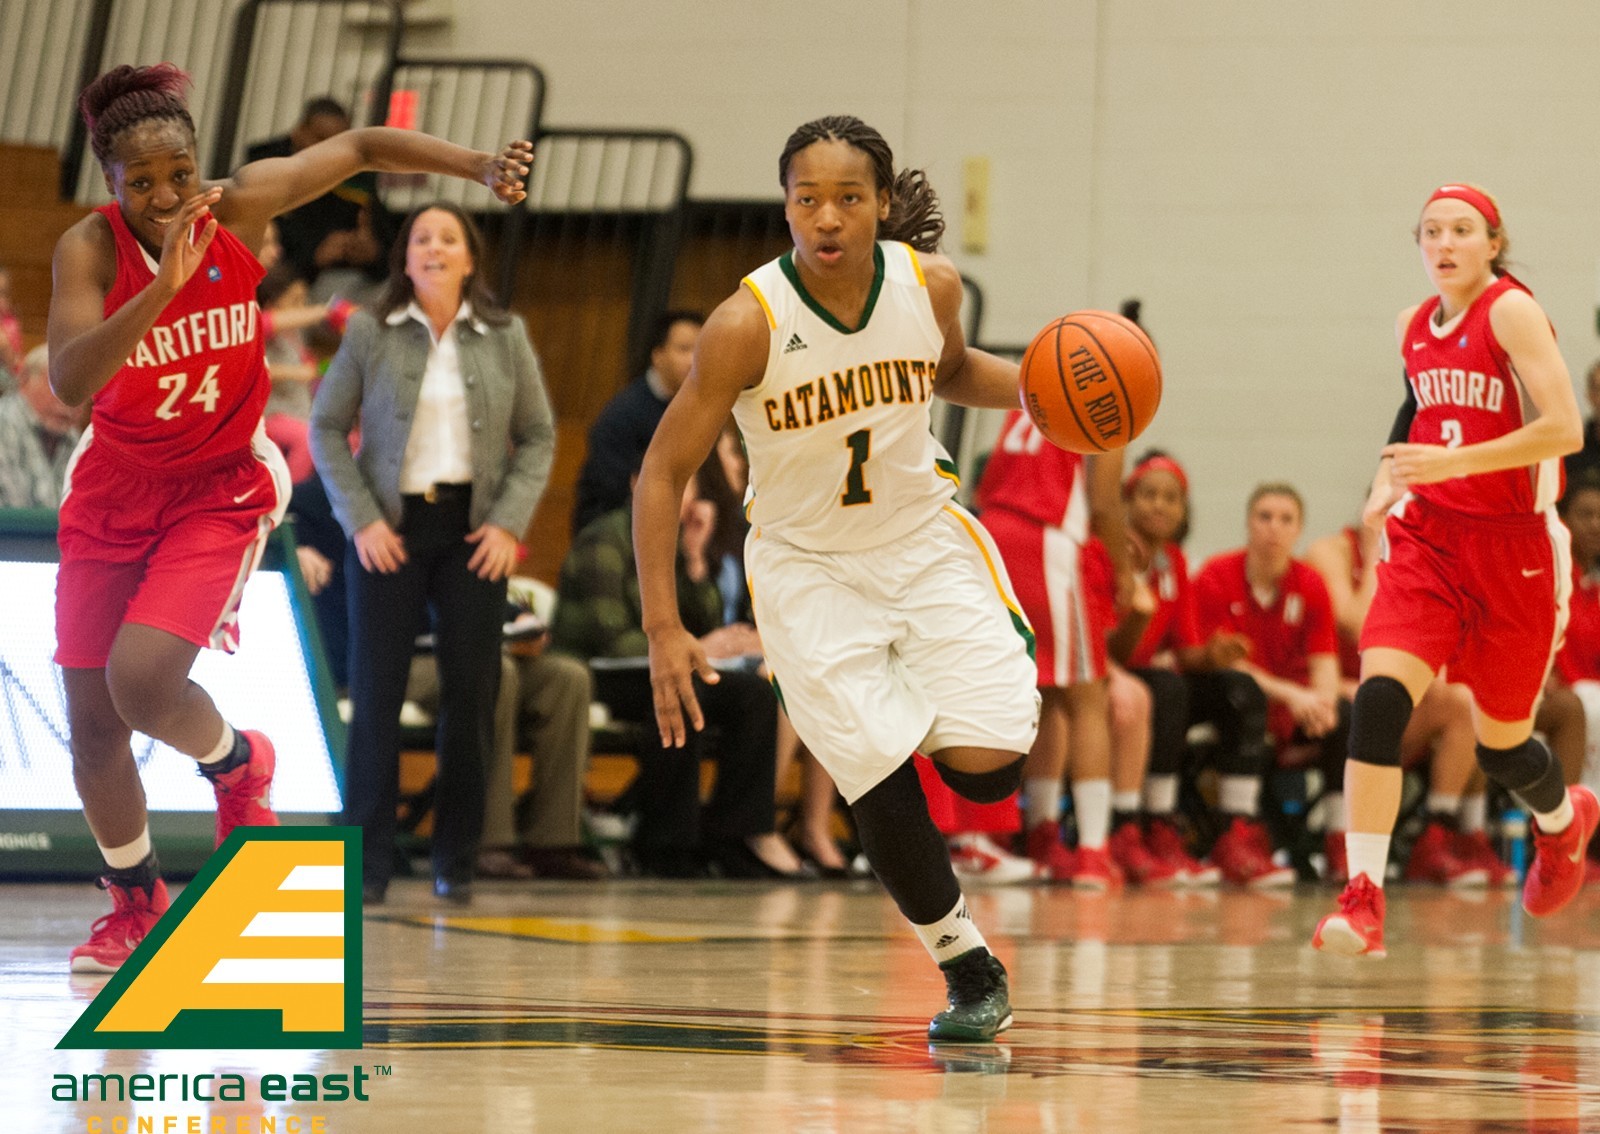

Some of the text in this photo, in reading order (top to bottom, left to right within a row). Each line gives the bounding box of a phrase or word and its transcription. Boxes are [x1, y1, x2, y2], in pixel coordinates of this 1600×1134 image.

[155, 364, 221, 421] 24
[1069, 345, 1122, 441] THE ROCK
[840, 427, 873, 507] 1
